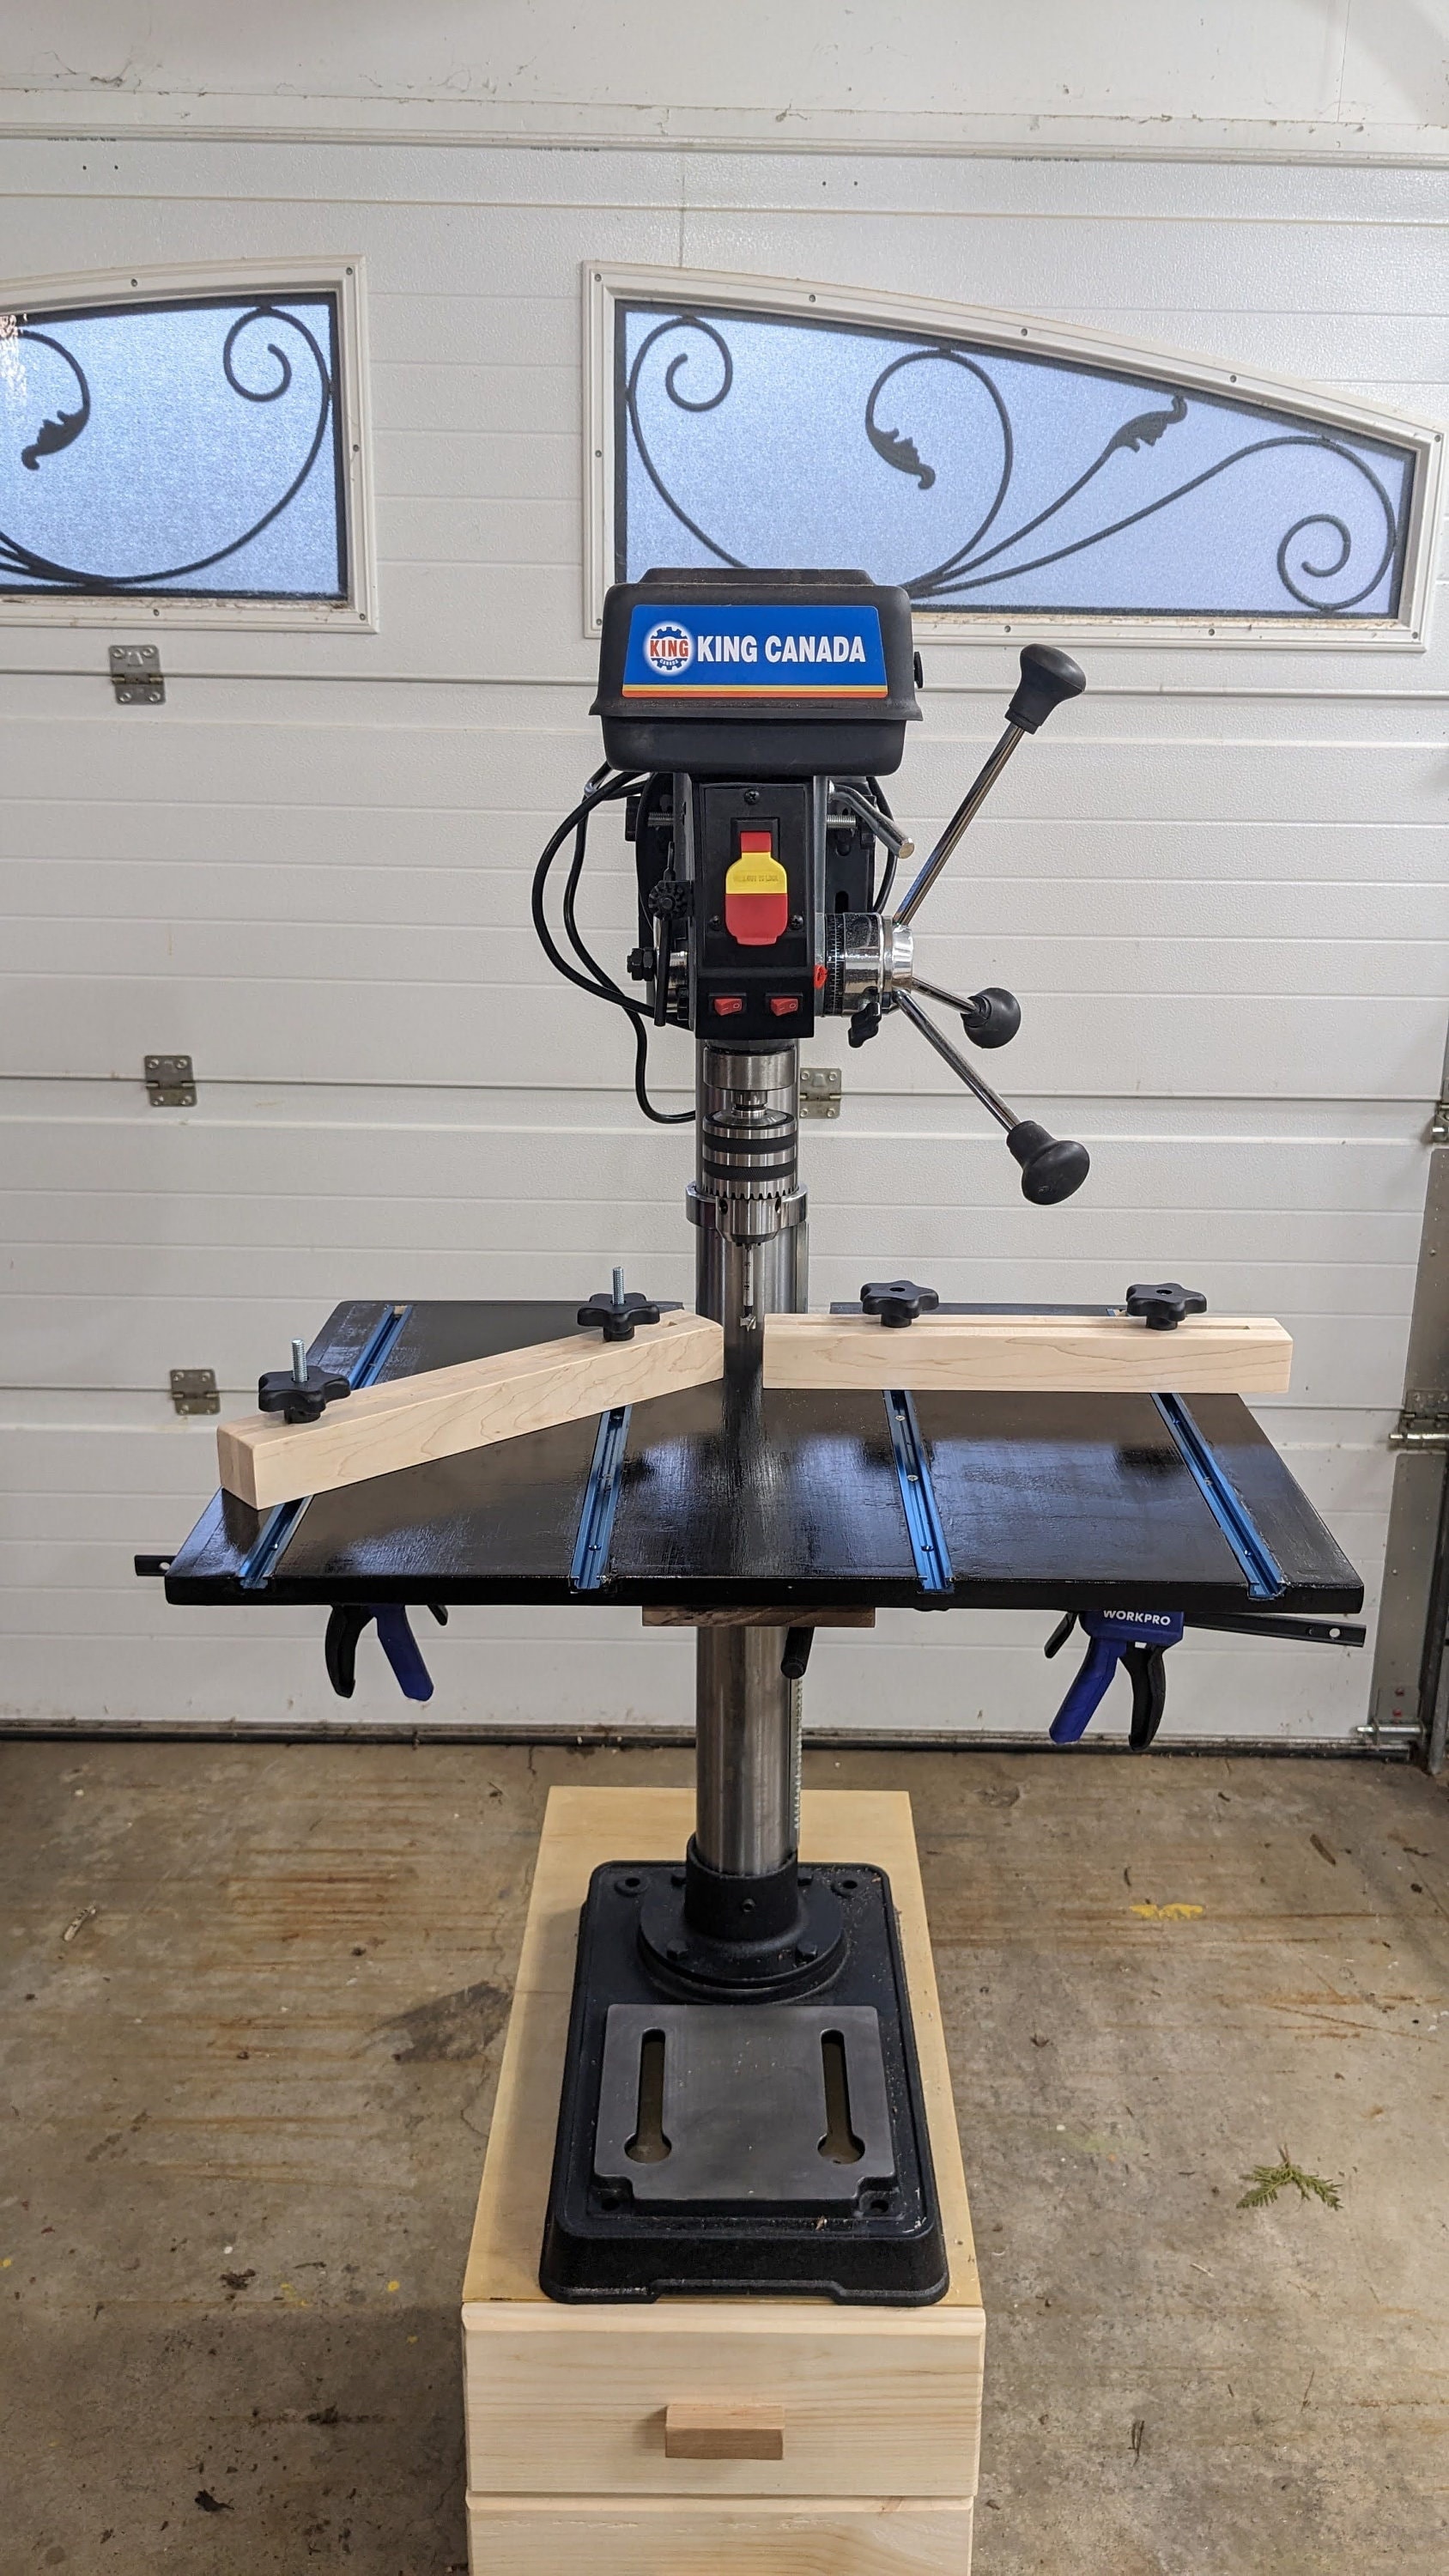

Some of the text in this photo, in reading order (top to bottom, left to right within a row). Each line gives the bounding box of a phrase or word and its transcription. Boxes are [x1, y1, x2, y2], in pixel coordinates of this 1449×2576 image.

[650, 640, 688, 657] KING
[698, 635, 866, 663] KING CANADA
[1103, 1610, 1171, 1625] WORKPRO
